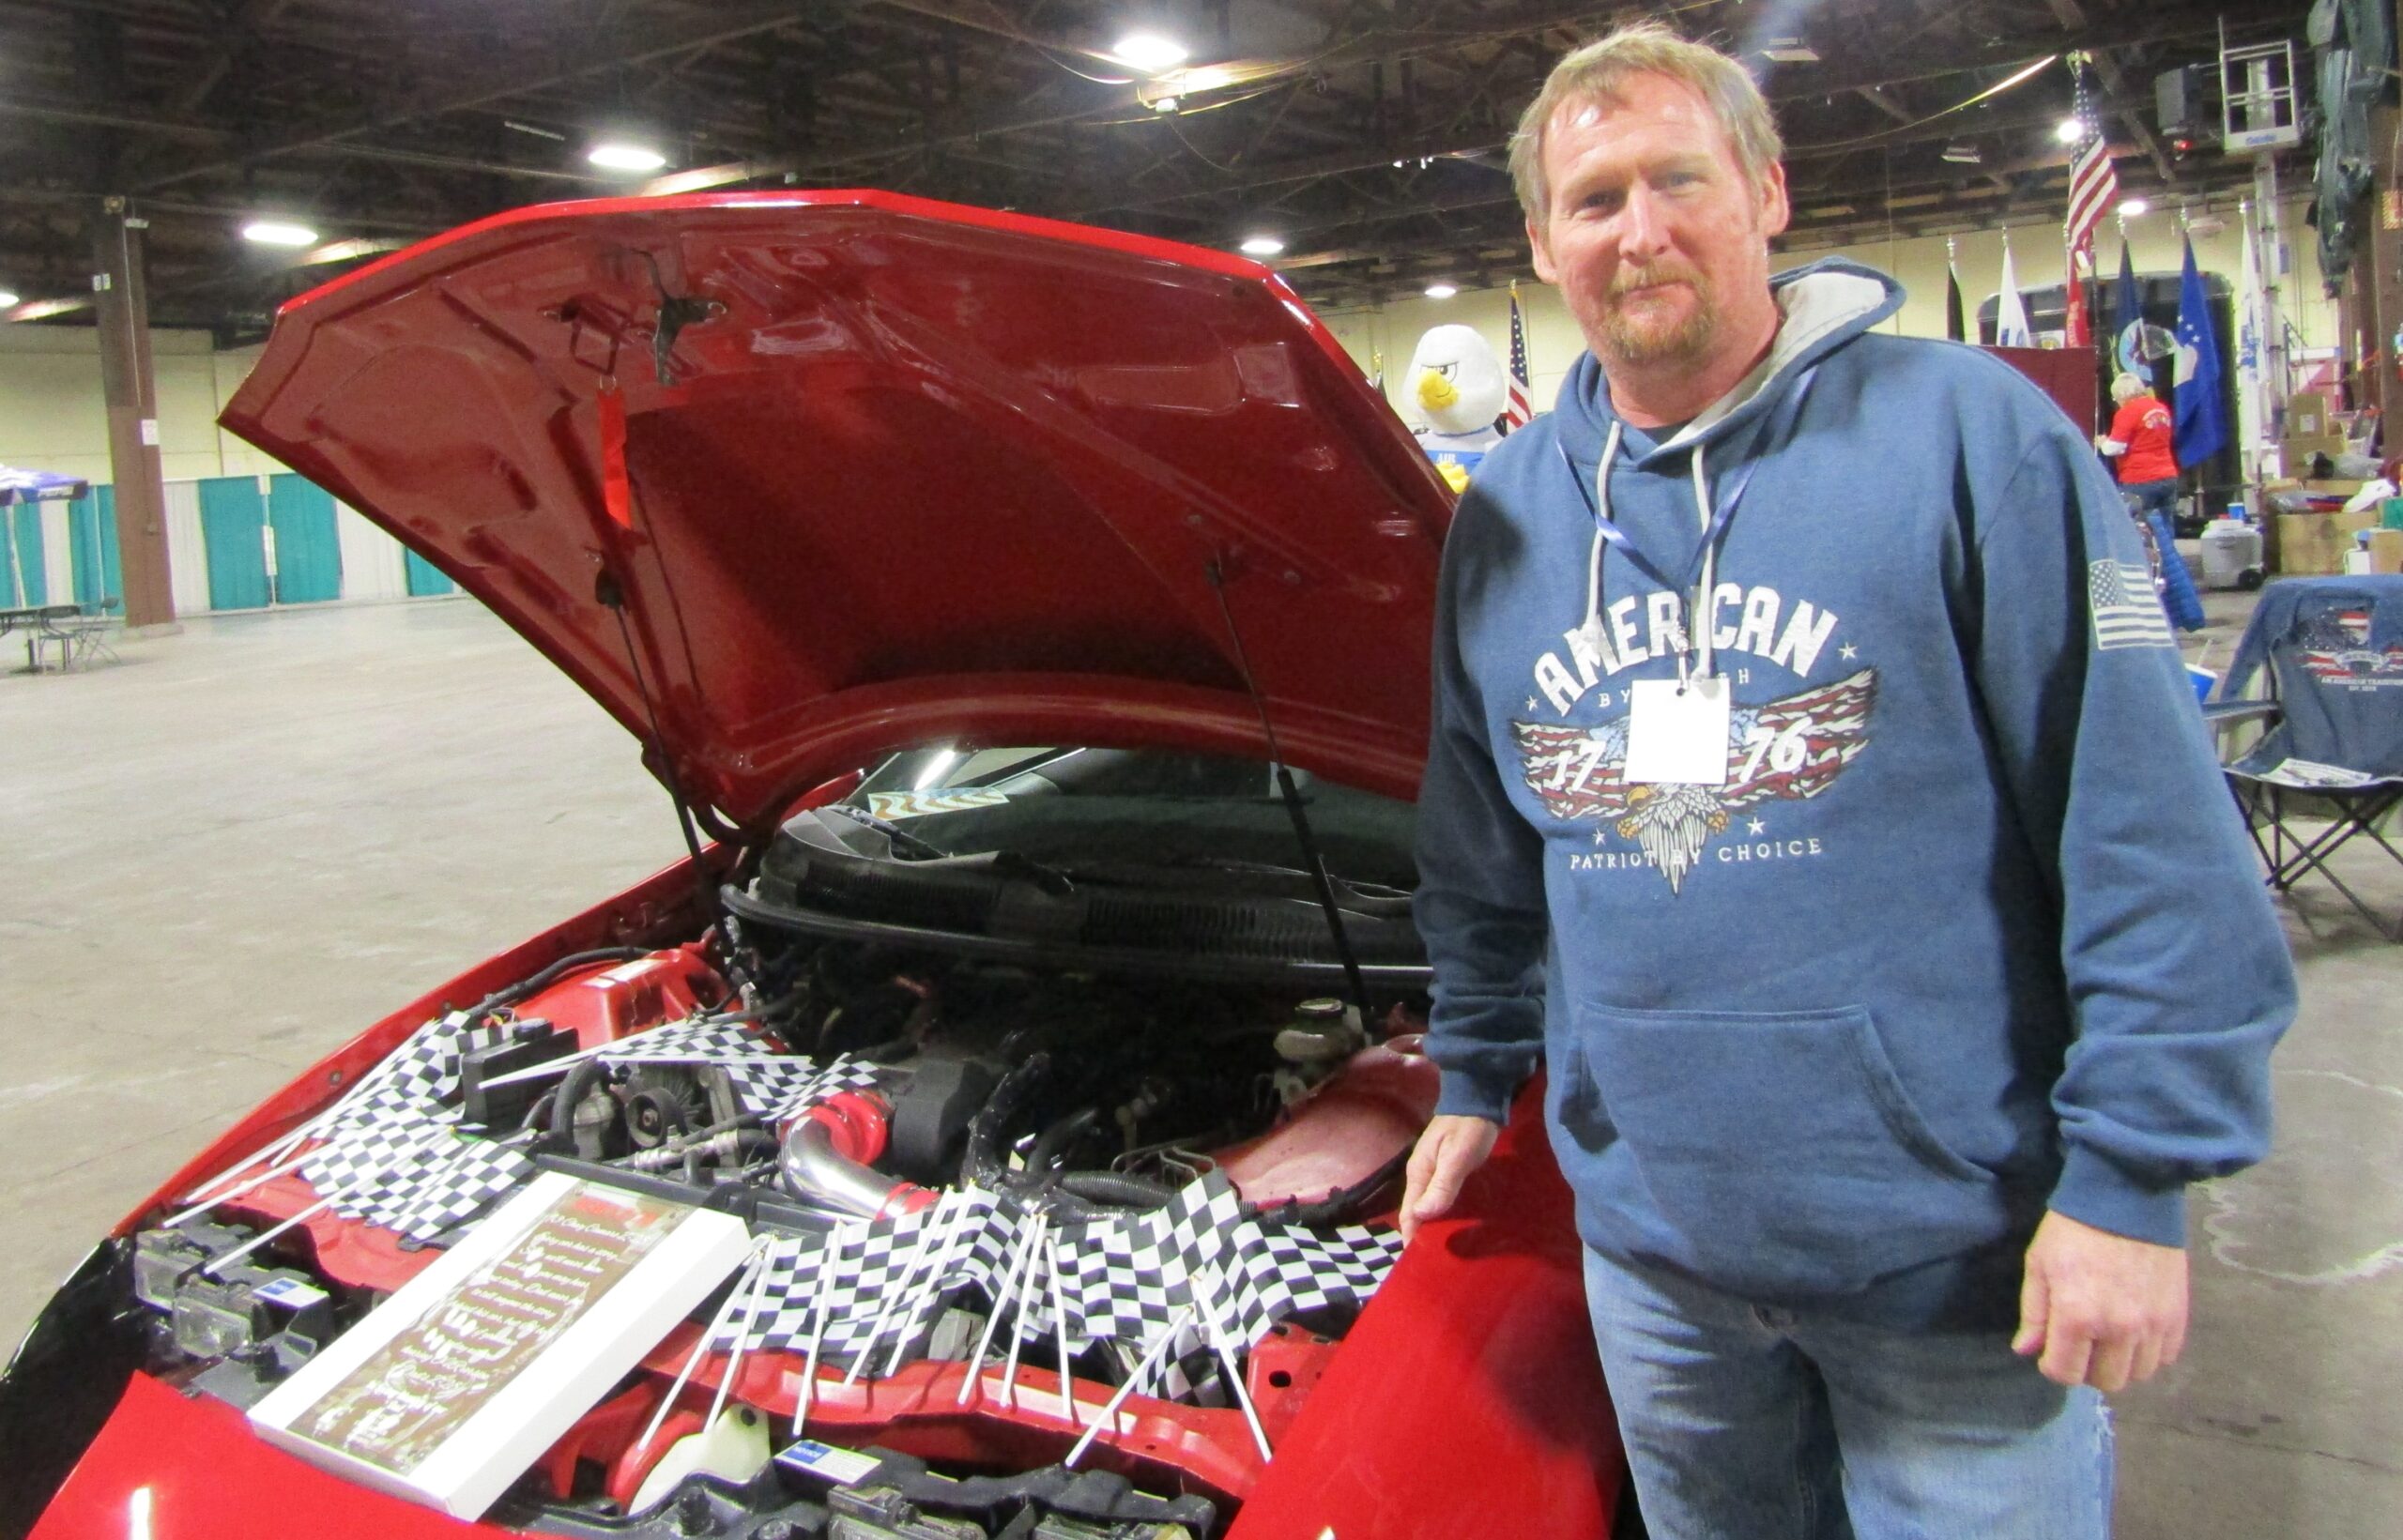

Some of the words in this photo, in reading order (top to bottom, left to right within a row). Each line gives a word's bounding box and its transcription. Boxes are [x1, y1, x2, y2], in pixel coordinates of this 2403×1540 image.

[1534, 582, 1838, 716] AMERICAN
[1599, 689, 1630, 708] BY
[1738, 716, 1813, 784] 76
[1569, 851, 1655, 870] PATRIOT
[1671, 848, 1701, 864] BY
[1718, 838, 1822, 862] CHOICE
